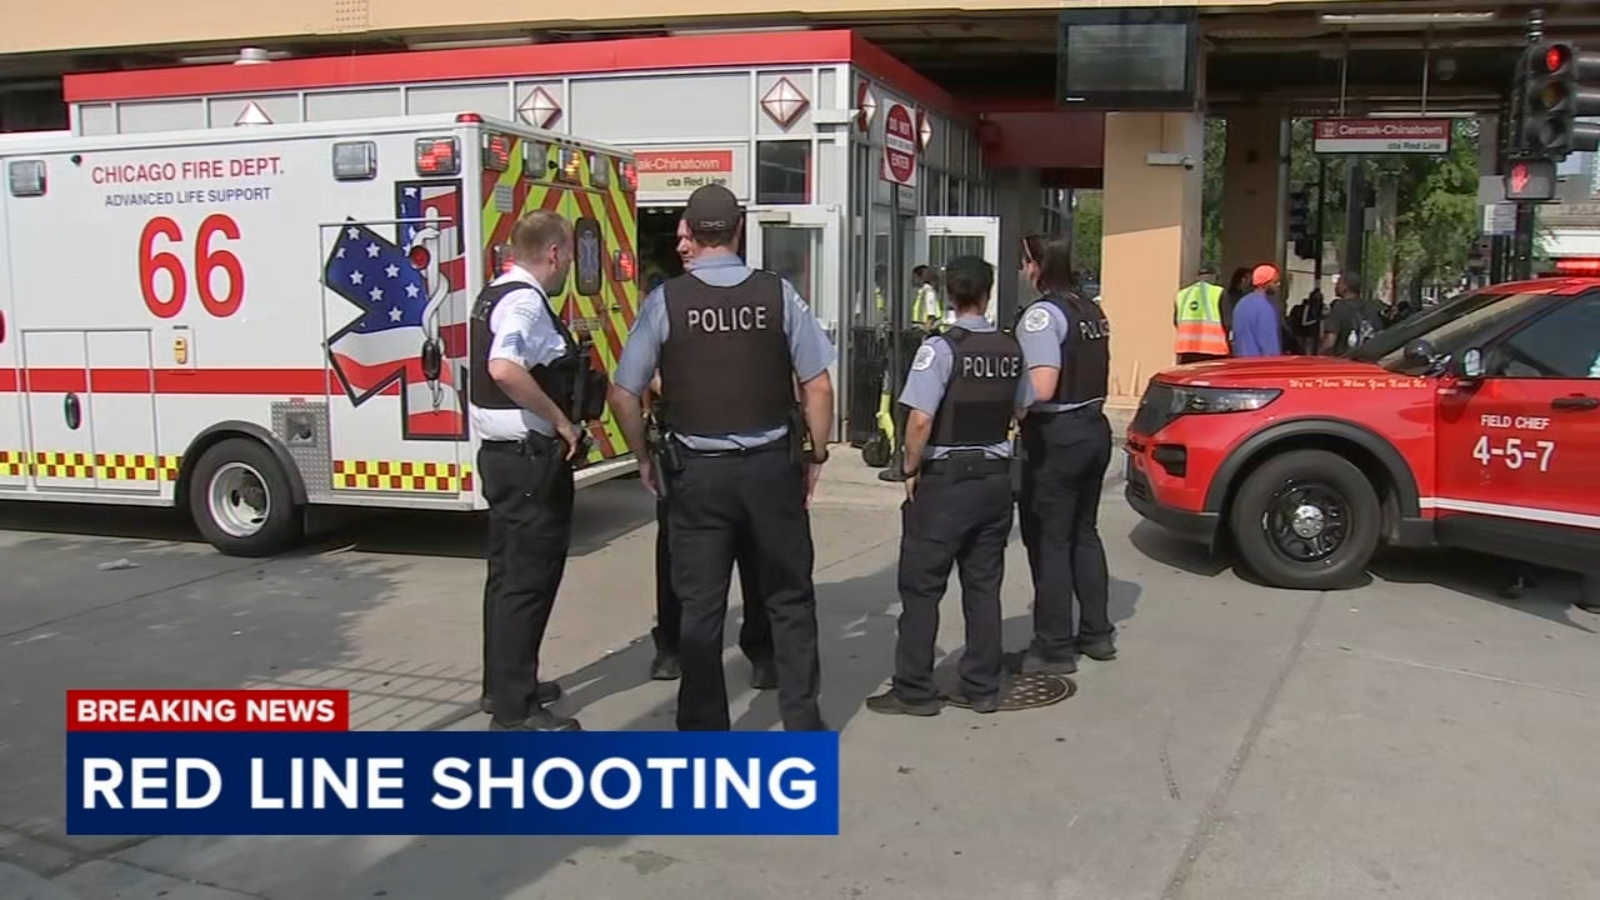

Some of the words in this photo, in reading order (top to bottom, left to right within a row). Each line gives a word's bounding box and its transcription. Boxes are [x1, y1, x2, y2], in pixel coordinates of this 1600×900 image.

[1339, 124, 1443, 135] Cermak-Chinatown
[92, 162, 176, 184] CHICAGO
[182, 160, 224, 180] FIRE
[229, 157, 284, 177] DEPT.
[638, 158, 720, 170] ak-Chinatown
[684, 177, 704, 187] Red
[105, 192, 174, 207] ADVANCED
[177, 190, 205, 203] LIFE
[208, 187, 272, 203] SUPPORT
[138, 213, 245, 319] 66
[687, 306, 767, 332] POLICE
[963, 356, 1020, 377] POLICE
[1480, 414, 1512, 428] FIELD
[1514, 416, 1551, 430] CHIEF
[1472, 435, 1555, 472] 4-5-7
